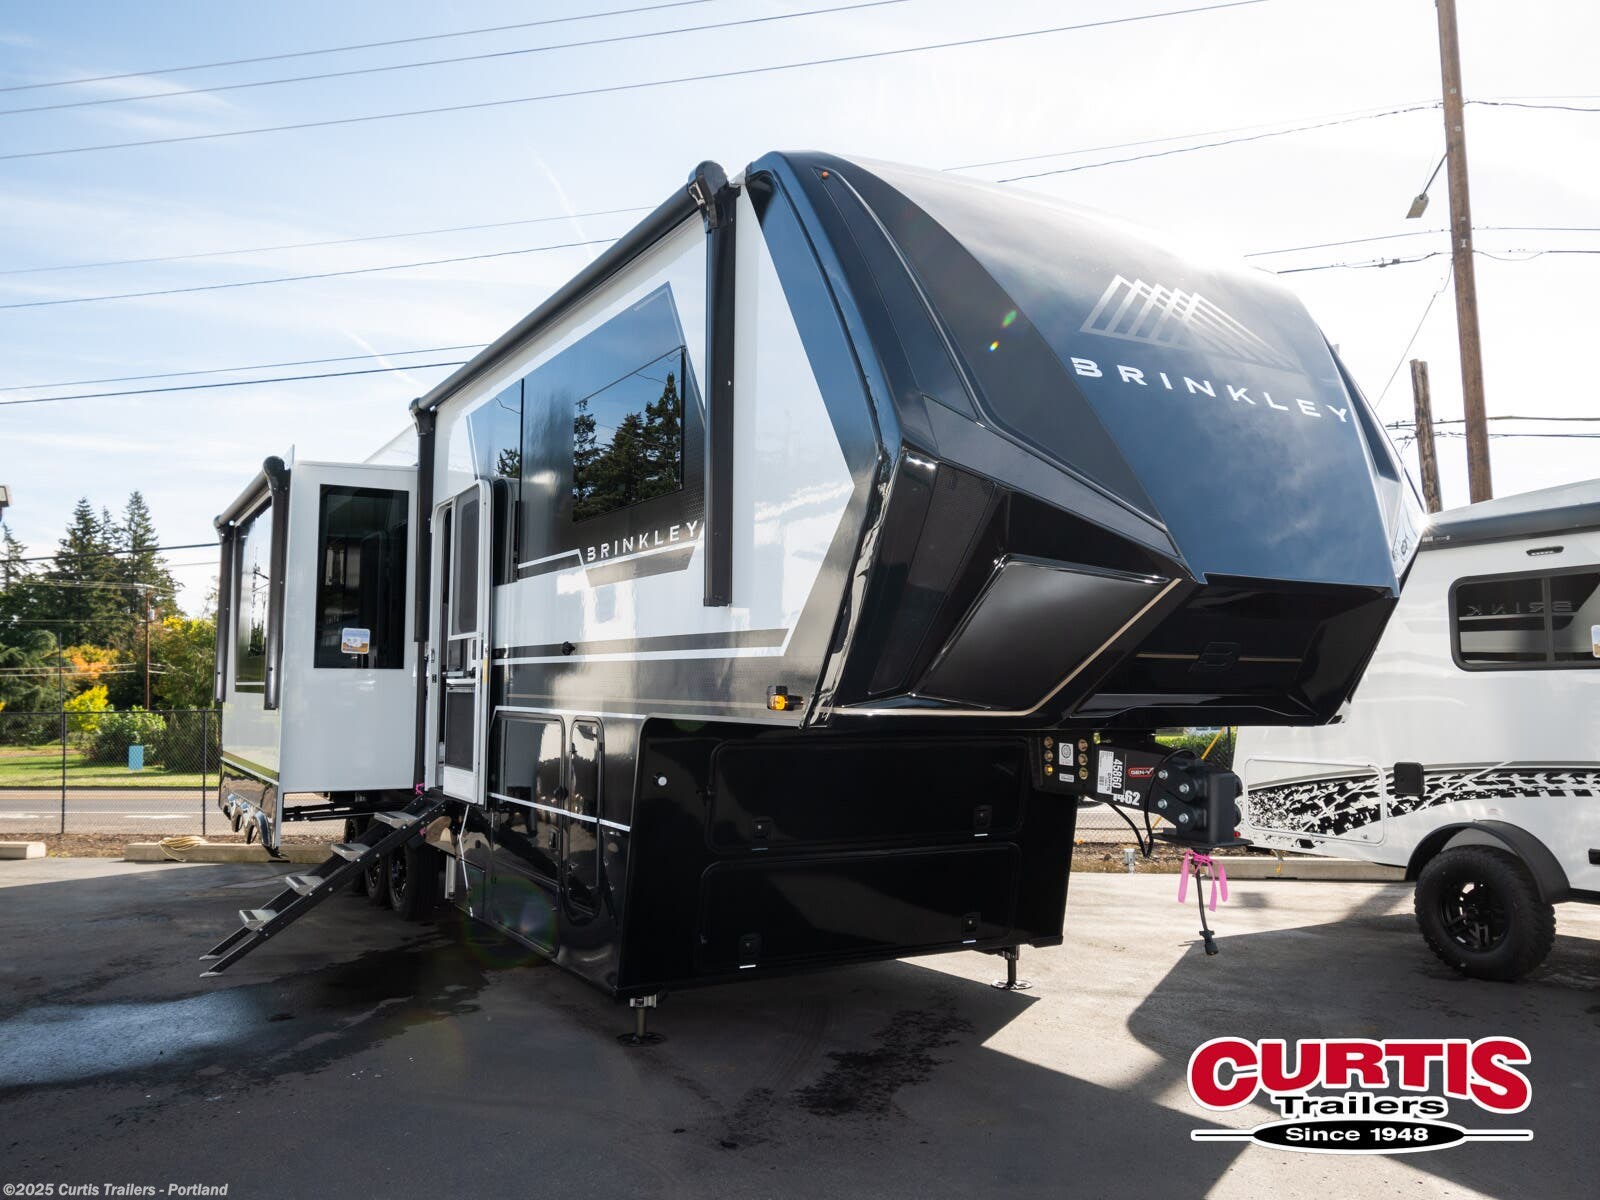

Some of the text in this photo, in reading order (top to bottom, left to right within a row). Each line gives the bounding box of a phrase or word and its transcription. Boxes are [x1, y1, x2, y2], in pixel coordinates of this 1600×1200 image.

[1070, 356, 1349, 423] BRINKLEY
[587, 520, 698, 562] BRINKLEY
[1112, 758, 1123, 789] 45860
